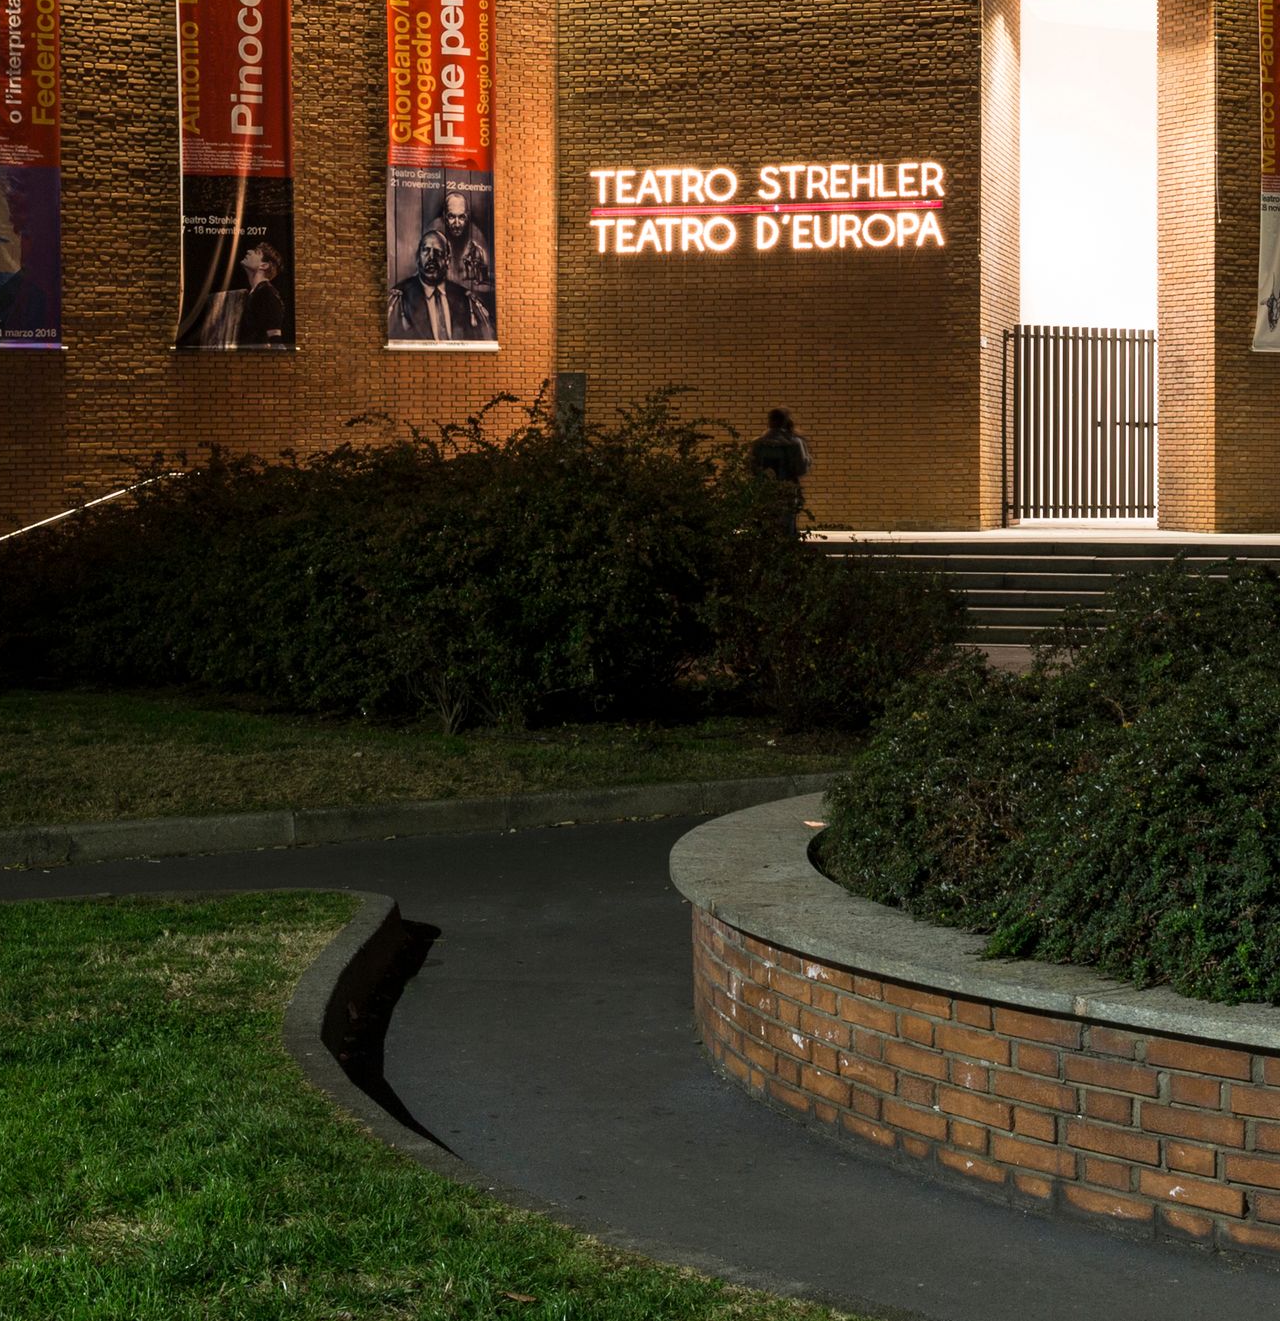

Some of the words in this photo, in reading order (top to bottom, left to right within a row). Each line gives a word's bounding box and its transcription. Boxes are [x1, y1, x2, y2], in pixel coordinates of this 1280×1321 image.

[478, 0, 489, 10] e
[476, 13, 489, 60] Leone
[181, 21, 201, 136] Antonio
[411, 11, 436, 145] Avogadro
[477, 64, 492, 114] Sergio
[9, 110, 23, 124] o
[434, 63, 465, 145] Fine
[480, 117, 489, 147] con
[1261, 90, 1276, 174] Marco
[390, 168, 415, 178] Teatro
[417, 170, 440, 179] Grassi
[401, 180, 440, 189] novembre
[446, 181, 456, 189] 22
[458, 182, 492, 192] dicembre
[589, 167, 738, 205] TEATRO
[757, 162, 945, 200] STREHLER
[194, 226, 204, 235] 18
[246, 226, 267, 236] 2017
[589, 216, 738, 254] TEATRO
[756, 212, 945, 251] D'EUROPA
[5, 330, 33, 338] marzo
[35, 328, 57, 338] 2018
